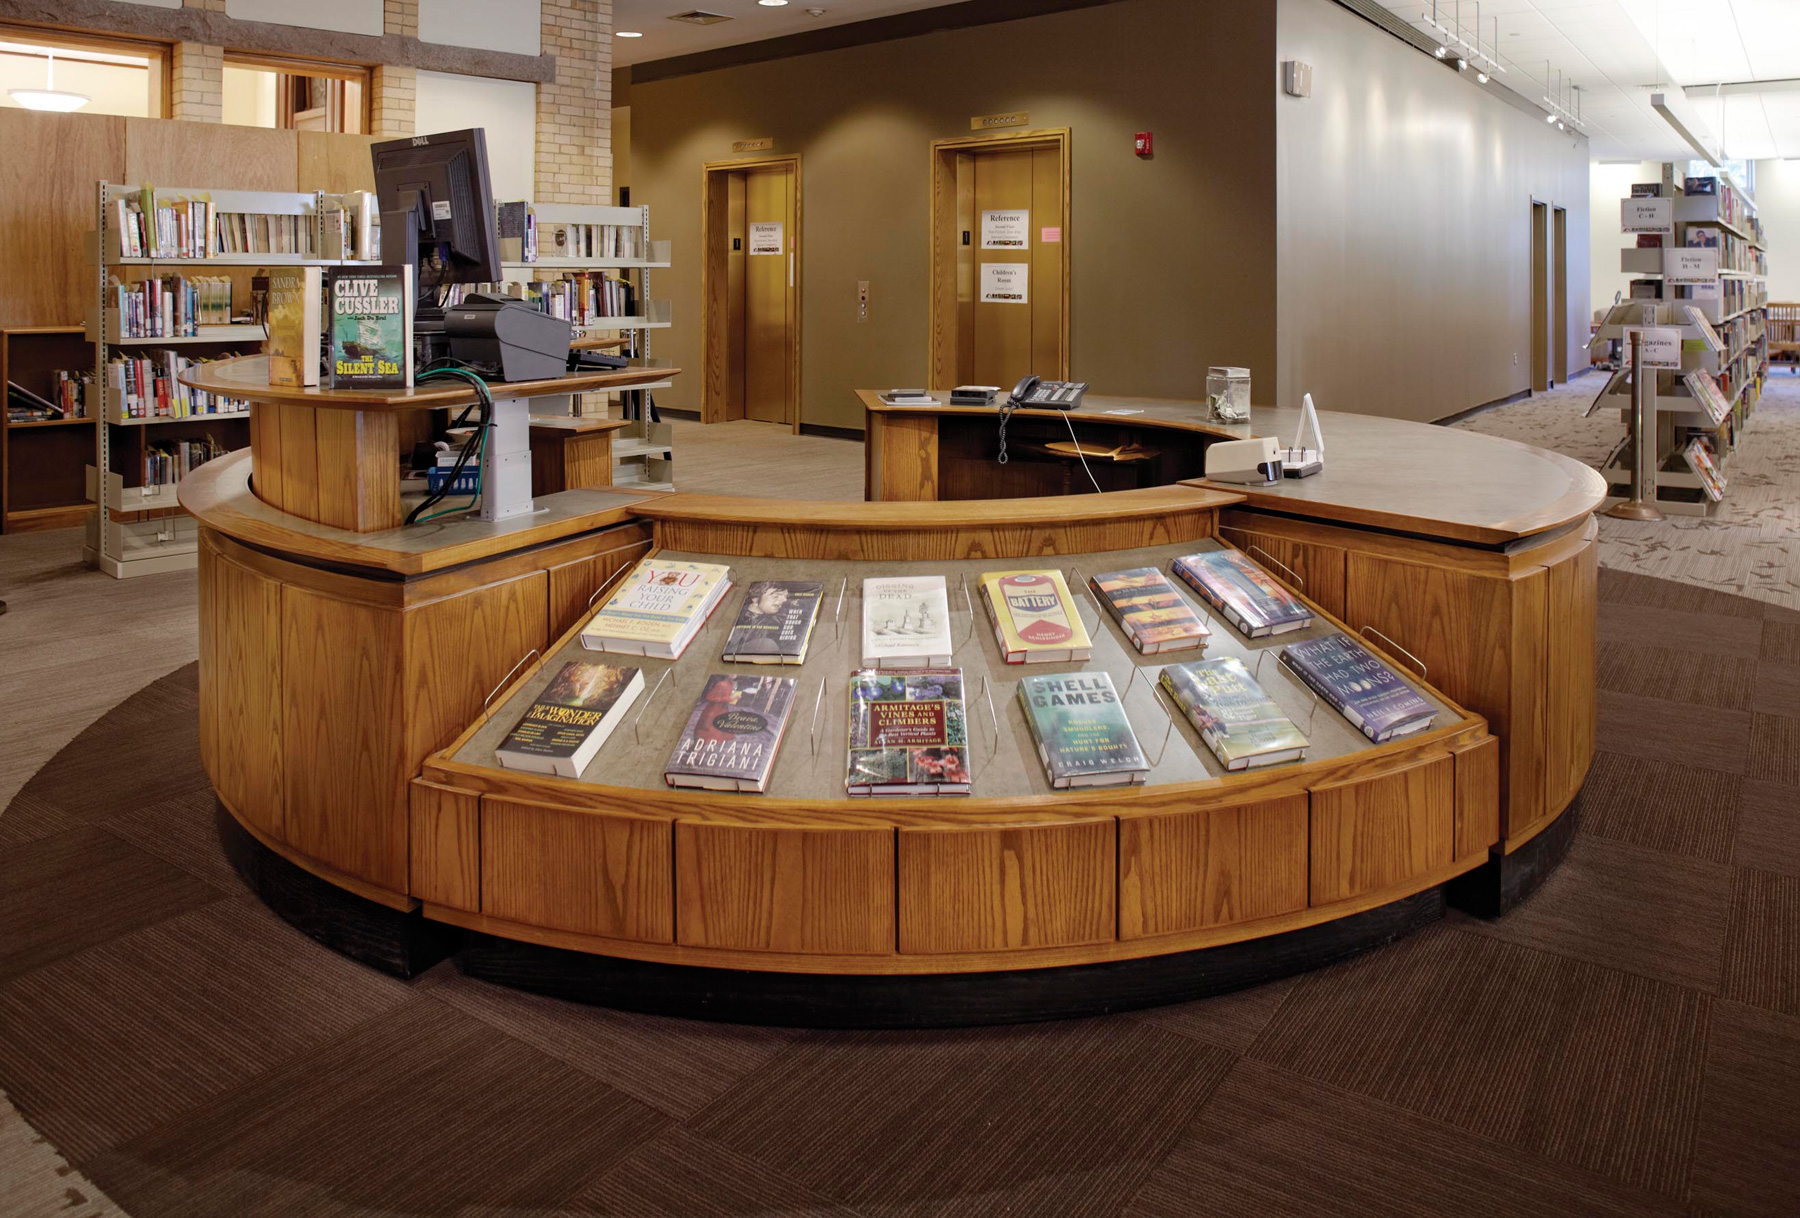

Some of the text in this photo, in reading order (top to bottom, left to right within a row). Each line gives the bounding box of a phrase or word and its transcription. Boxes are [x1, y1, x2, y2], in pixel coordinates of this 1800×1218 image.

[412, 137, 429, 147] DELL
[272, 277, 300, 289] SANDRA
[335, 280, 378, 296] CLIVE
[272, 290, 300, 305] BROWN
[334, 297, 399, 314] CUSSLER
[336, 360, 399, 375] SILENT SEA
[638, 584, 689, 596] RAISING
[640, 593, 673, 603] YOUR
[1010, 595, 1055, 608] BATTERY
[630, 601, 671, 611] CHILD
[1292, 637, 1351, 659] WHAT IF
[1309, 649, 1367, 670] THE EARTH
[1322, 660, 1380, 683] HAD TWO
[1032, 678, 1107, 694] SHELL
[1032, 691, 1116, 708] GAMES
[550, 706, 603, 720] WONDER
[874, 704, 941, 712] ARMITAGE'S
[530, 711, 598, 726] IMAGINATION
[878, 718, 937, 726] CLIMBERS
[681, 738, 763, 758] ADRIANA
[674, 750, 759, 770] TRIGIANI
[1058, 756, 1140, 768] CRAIG WELCH
